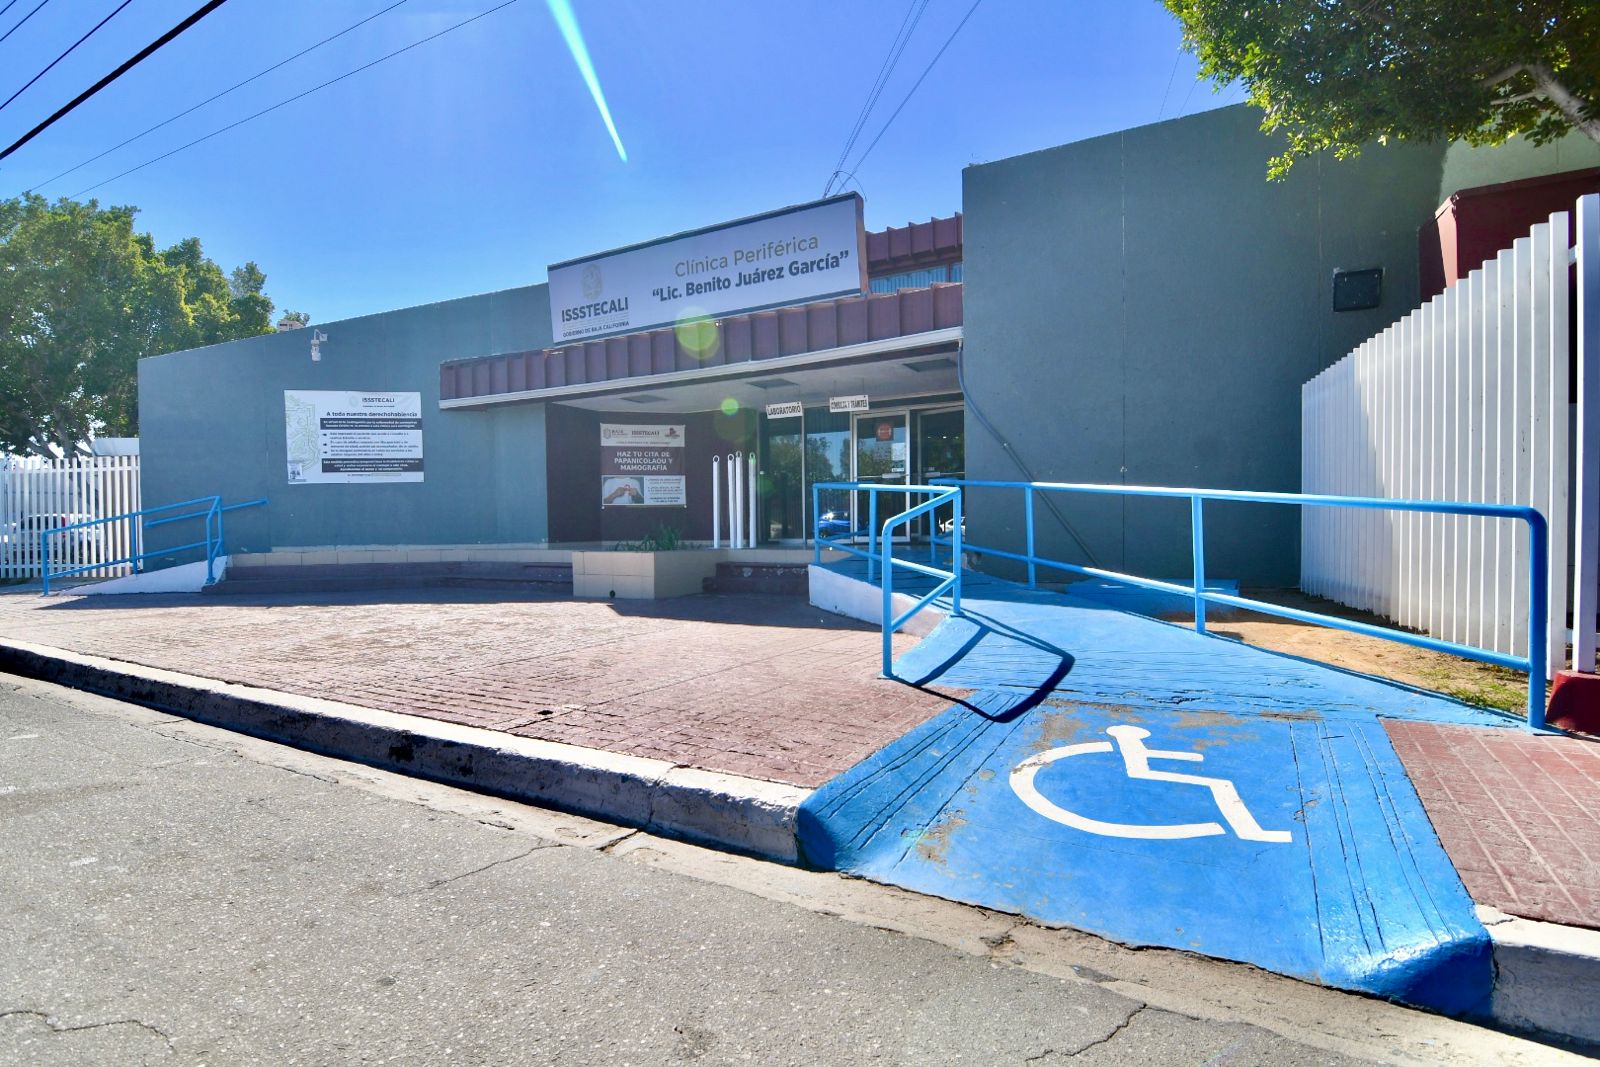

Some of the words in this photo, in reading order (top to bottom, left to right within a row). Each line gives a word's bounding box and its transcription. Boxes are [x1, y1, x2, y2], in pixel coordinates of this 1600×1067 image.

[675, 254, 729, 278] Clínica
[734, 235, 819, 266] Periférica
[652, 285, 682, 302] “Lic.
[686, 276, 731, 297] Benito
[735, 265, 784, 287] Juárez
[788, 250, 849, 276] García”
[561, 297, 629, 323] ISSSTECALI
[602, 321, 630, 330] CALIFORNIA
[768, 405, 801, 416] LABORATORIO
